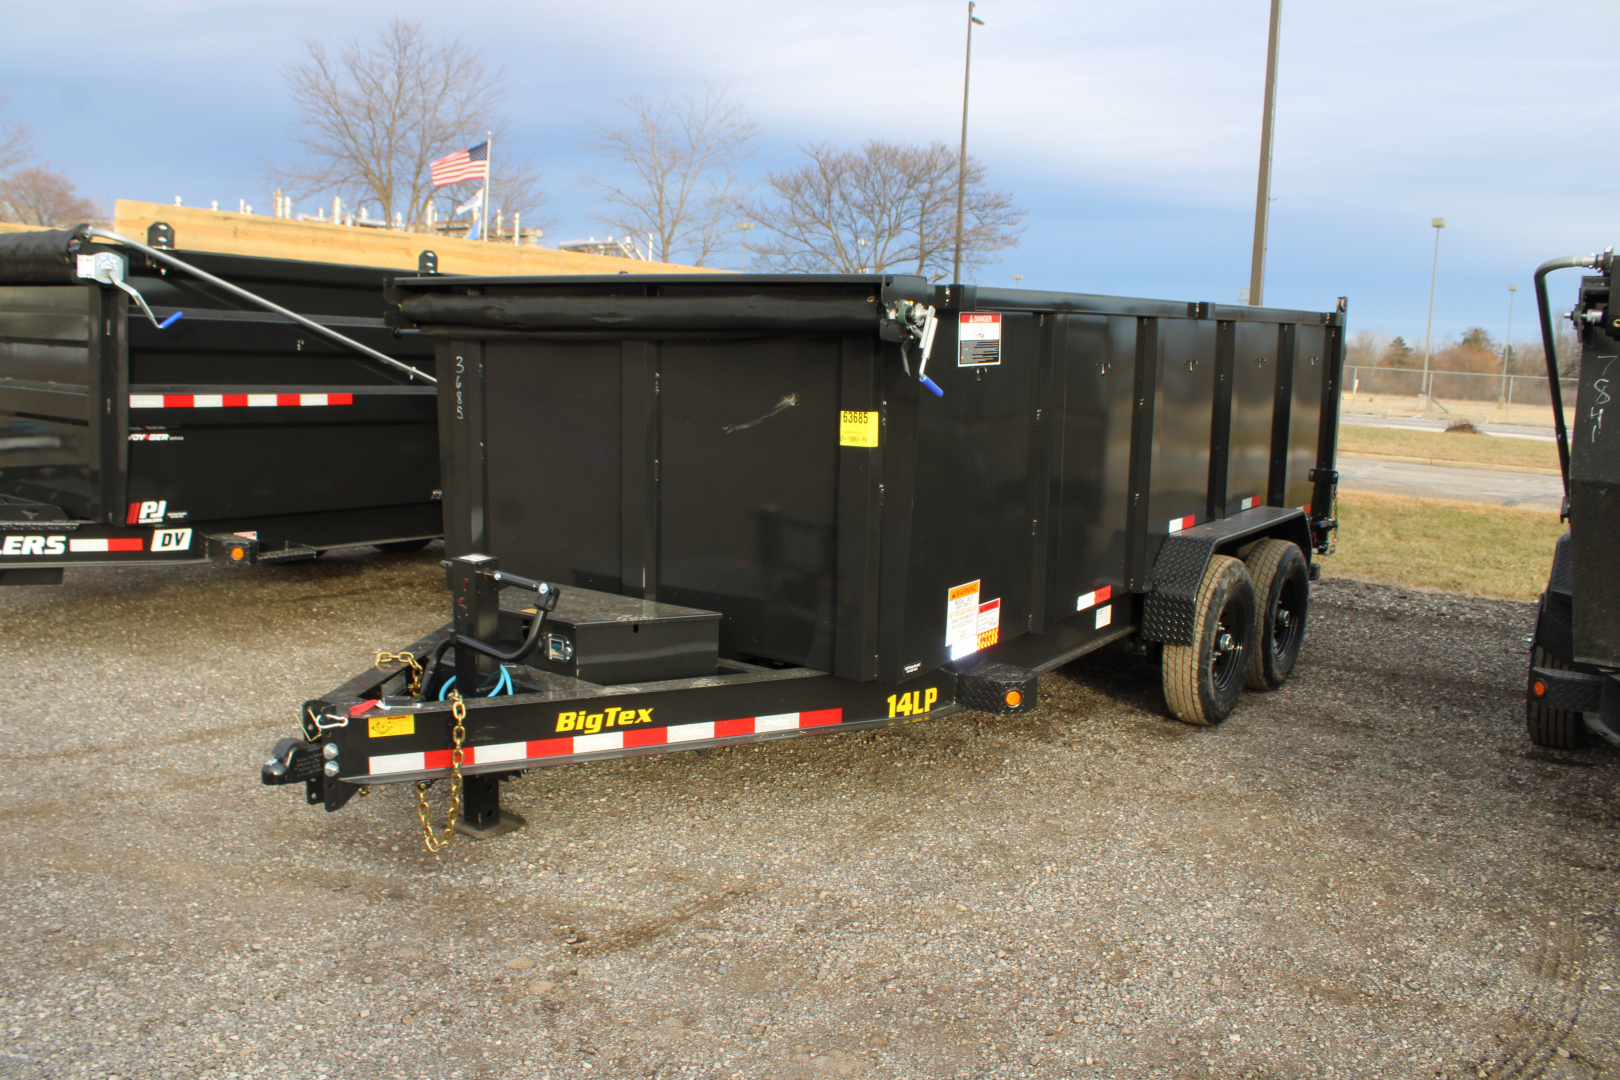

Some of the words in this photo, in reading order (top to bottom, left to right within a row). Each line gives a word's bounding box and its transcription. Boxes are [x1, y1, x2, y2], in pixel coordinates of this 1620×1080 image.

[455, 356, 465, 420] 3685
[843, 411, 868, 424] 63685
[138, 500, 167, 519] PJ
[0, 535, 67, 555] ERS
[161, 532, 185, 547] DV
[956, 585, 977, 596] WARNING
[887, 687, 938, 718] 14LP
[555, 706, 654, 734] BigTex
